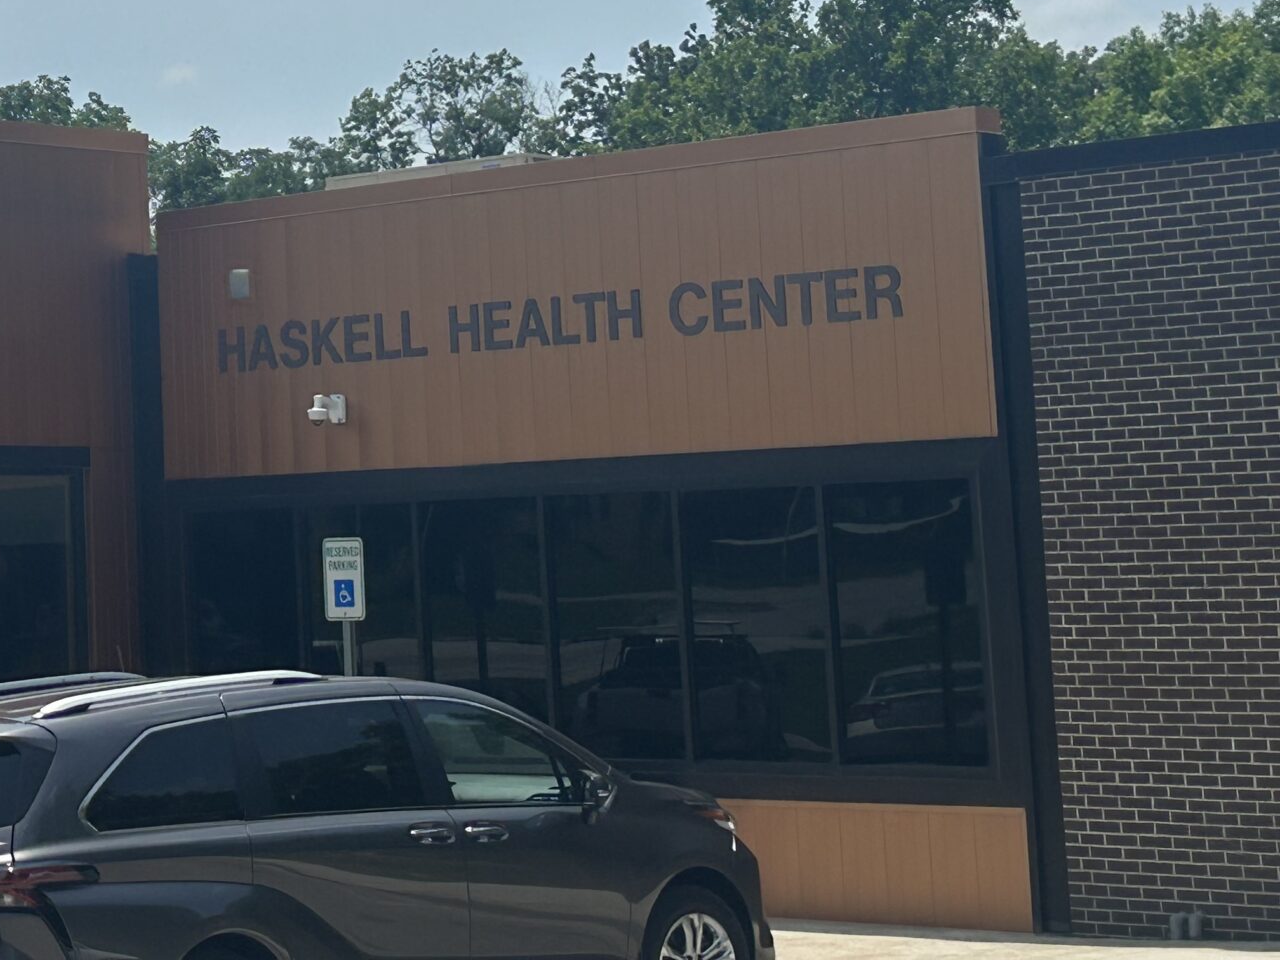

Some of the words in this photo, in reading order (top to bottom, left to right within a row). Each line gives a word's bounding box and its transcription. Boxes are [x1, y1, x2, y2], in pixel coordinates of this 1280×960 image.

[218, 310, 429, 374] HASKELL
[448, 288, 644, 354] HEALTH
[669, 265, 904, 337] CENTER
[325, 546, 359, 557] RESERVED
[328, 560, 358, 571] PARKING
